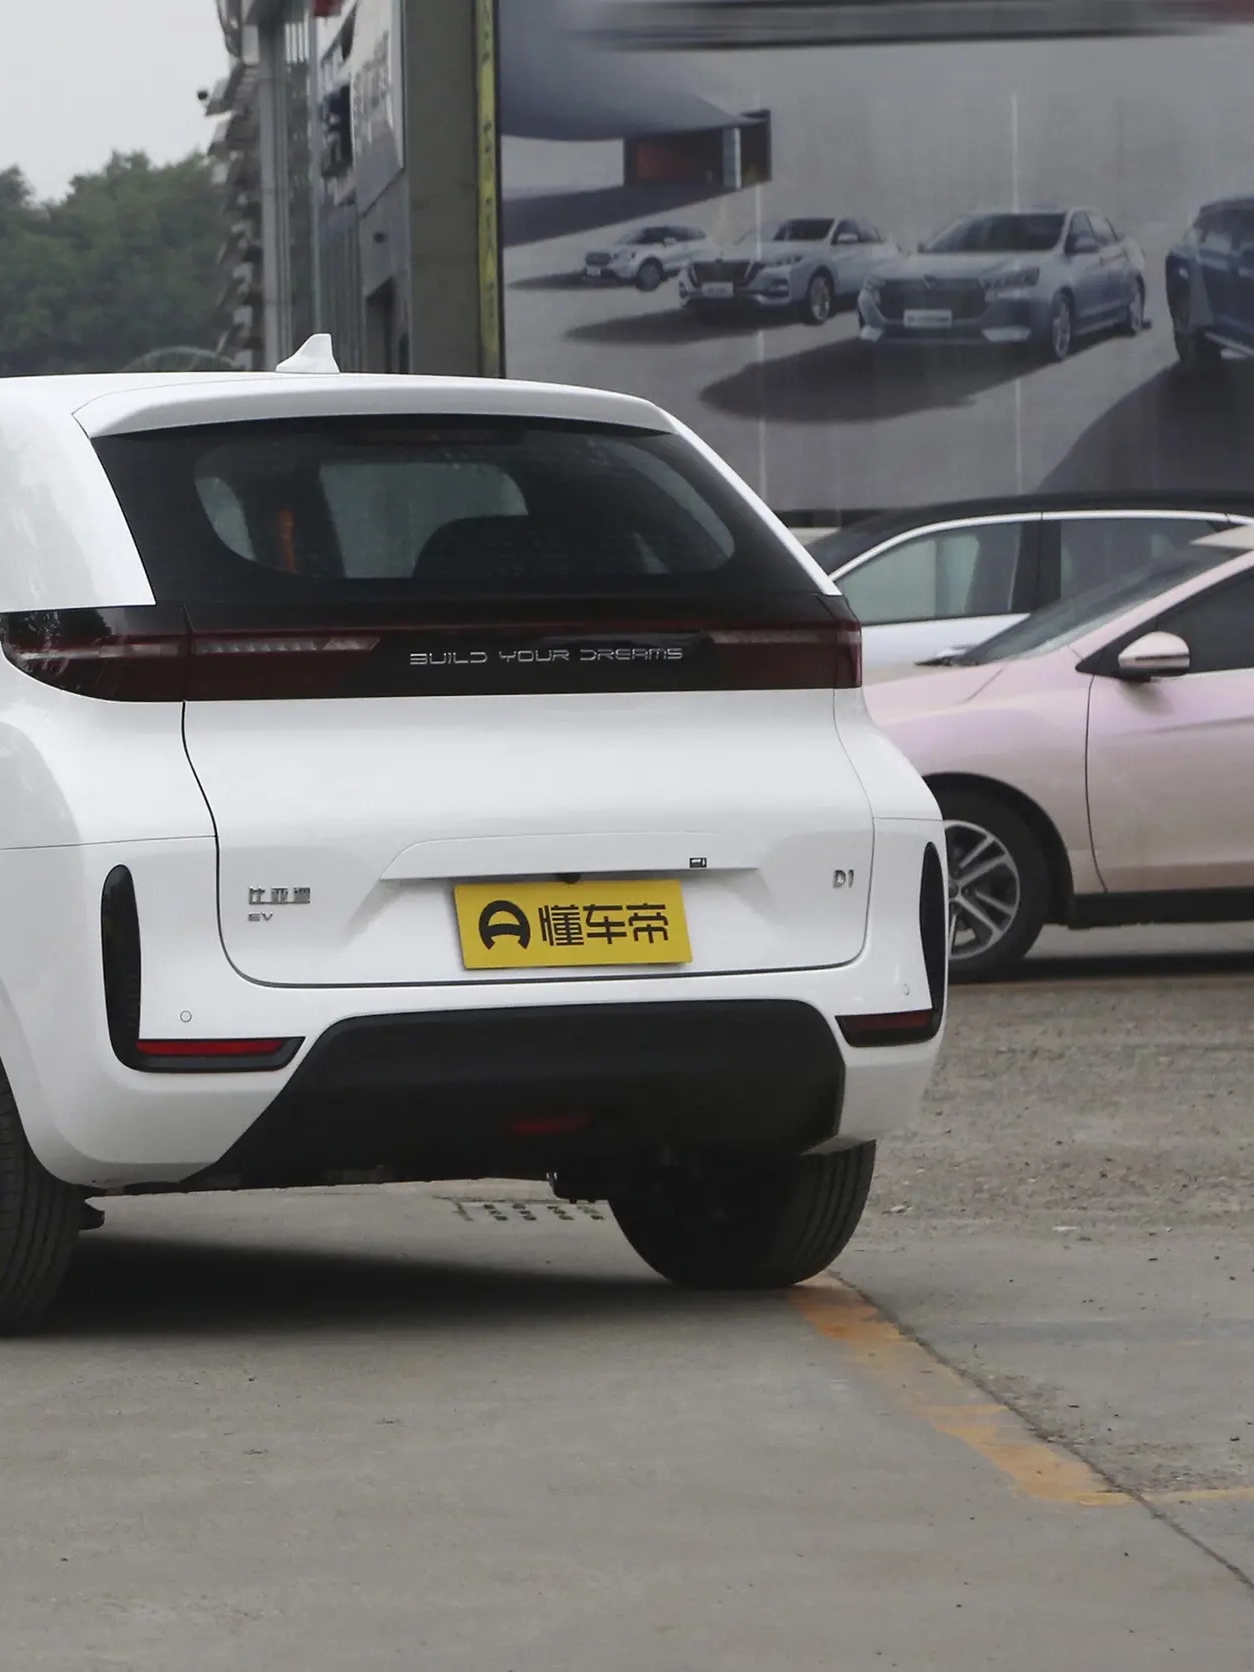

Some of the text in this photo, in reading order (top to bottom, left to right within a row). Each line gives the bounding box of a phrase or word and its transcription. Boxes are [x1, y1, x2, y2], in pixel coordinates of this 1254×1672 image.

[409, 647, 684, 666] BUILD YOUR DREAMS
[832, 868, 855, 889] D1
[248, 885, 311, 905] 比亚迪
[248, 911, 275, 922] EV
[538, 903, 670, 947] 懂车帝
